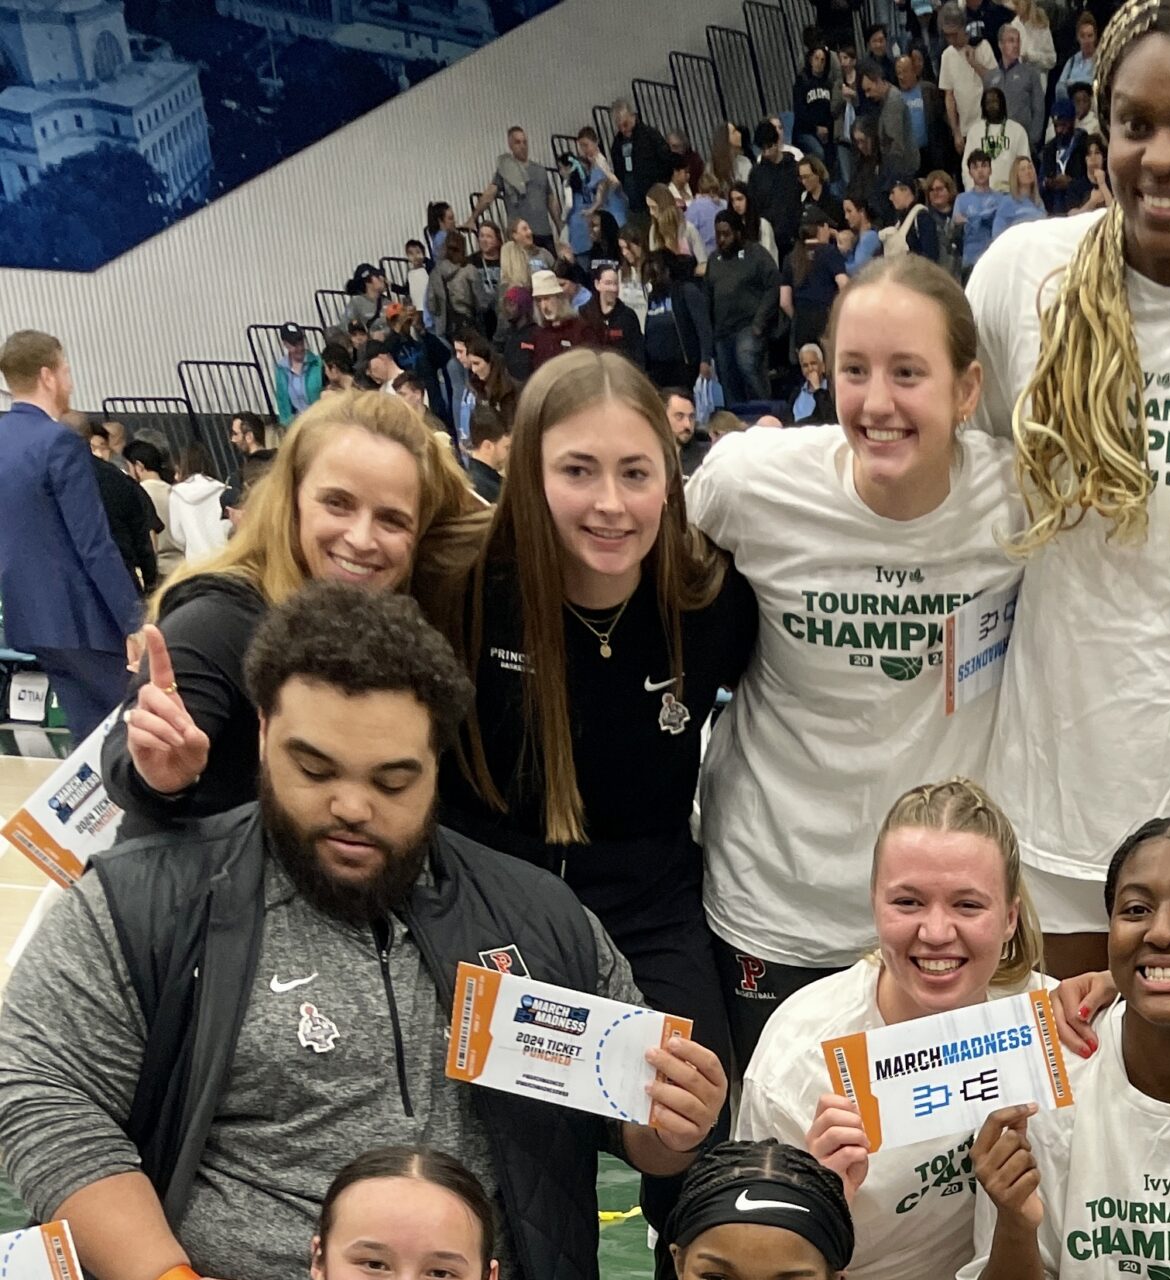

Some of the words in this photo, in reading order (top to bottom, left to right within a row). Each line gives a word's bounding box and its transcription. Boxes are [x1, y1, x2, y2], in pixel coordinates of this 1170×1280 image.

[875, 566, 907, 588] Ivy
[802, 590, 979, 615] TOURNAME
[782, 612, 943, 651] CHAMPI
[851, 655, 870, 667] 20
[532, 999, 570, 1017] MARCH
[534, 1012, 587, 1034] MADNESS
[516, 1032, 544, 1048] 2024
[546, 1038, 582, 1057] TICKET
[522, 1045, 572, 1067] PUNCHED
[1121, 1261, 1140, 1273] 20
